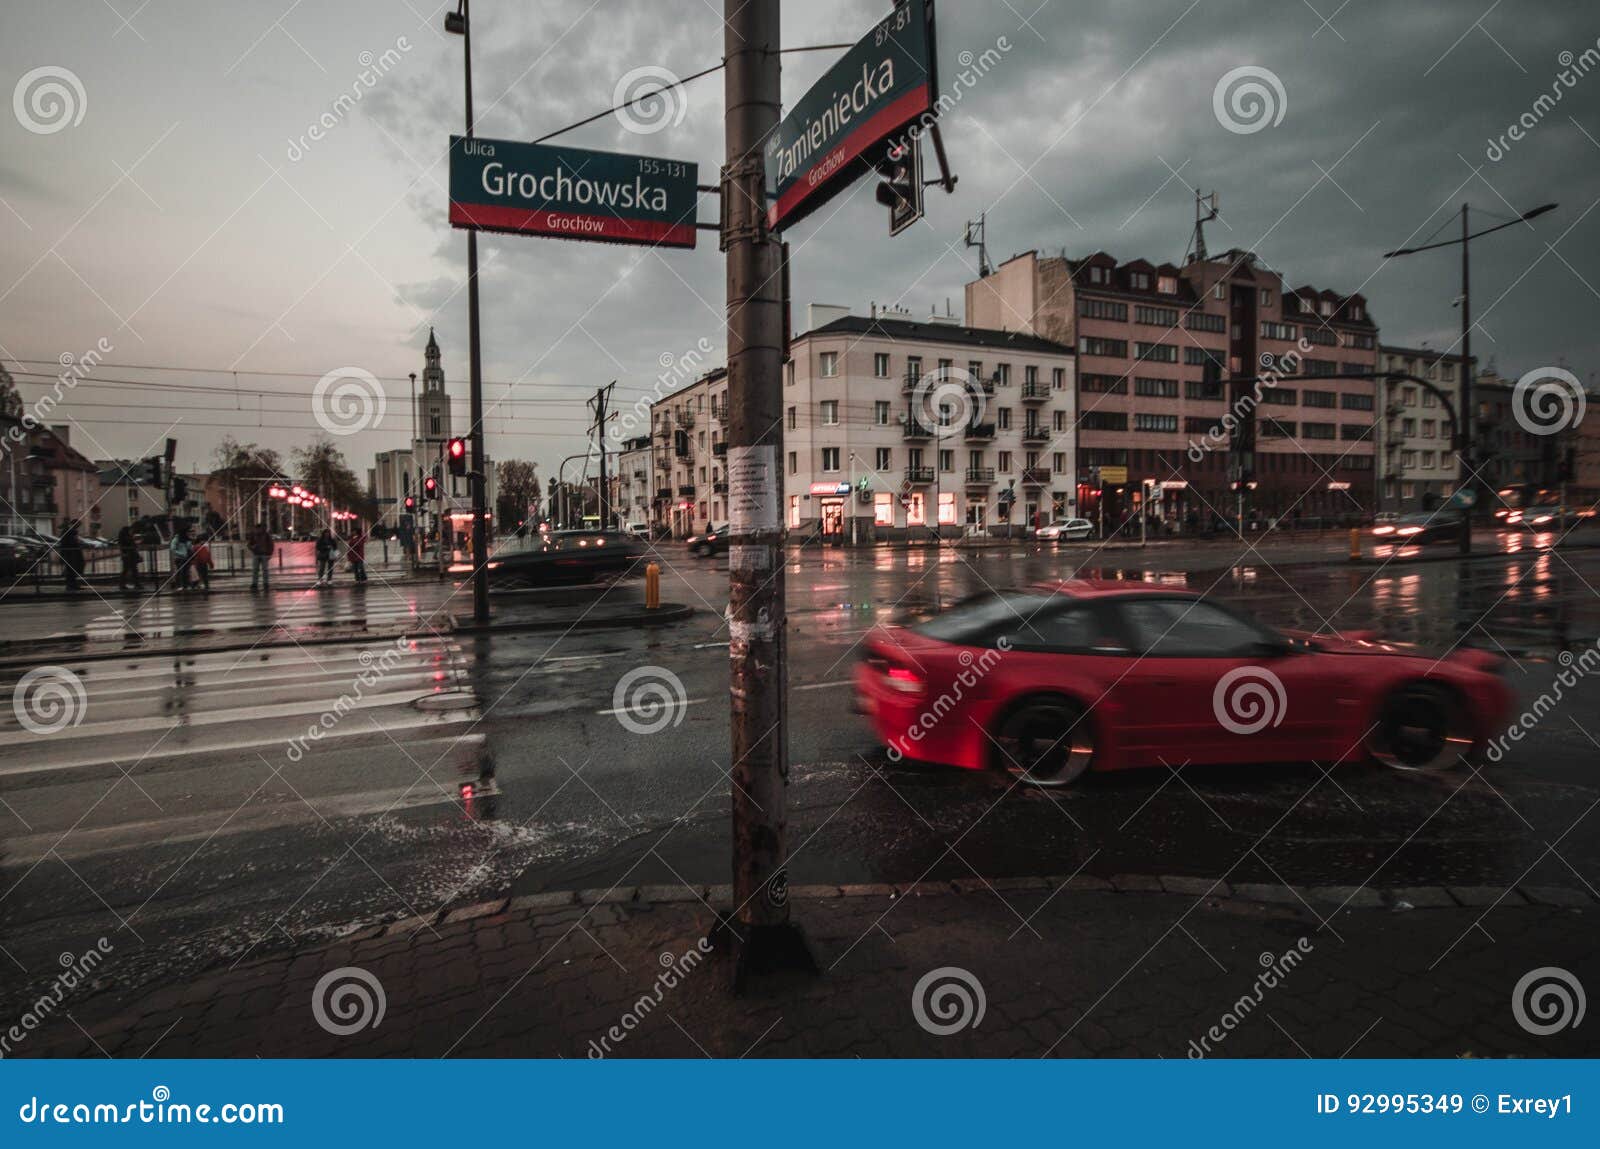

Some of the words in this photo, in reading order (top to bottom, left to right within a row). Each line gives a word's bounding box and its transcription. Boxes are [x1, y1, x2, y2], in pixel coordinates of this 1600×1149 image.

[875, 6, 912, 47] 87-81
[776, 57, 895, 186] Zamieniecka
[464, 140, 495, 157] Ulica
[638, 158, 687, 179] 155-131
[481, 162, 667, 212] Grochowska
[546, 214, 605, 233] Grochów
